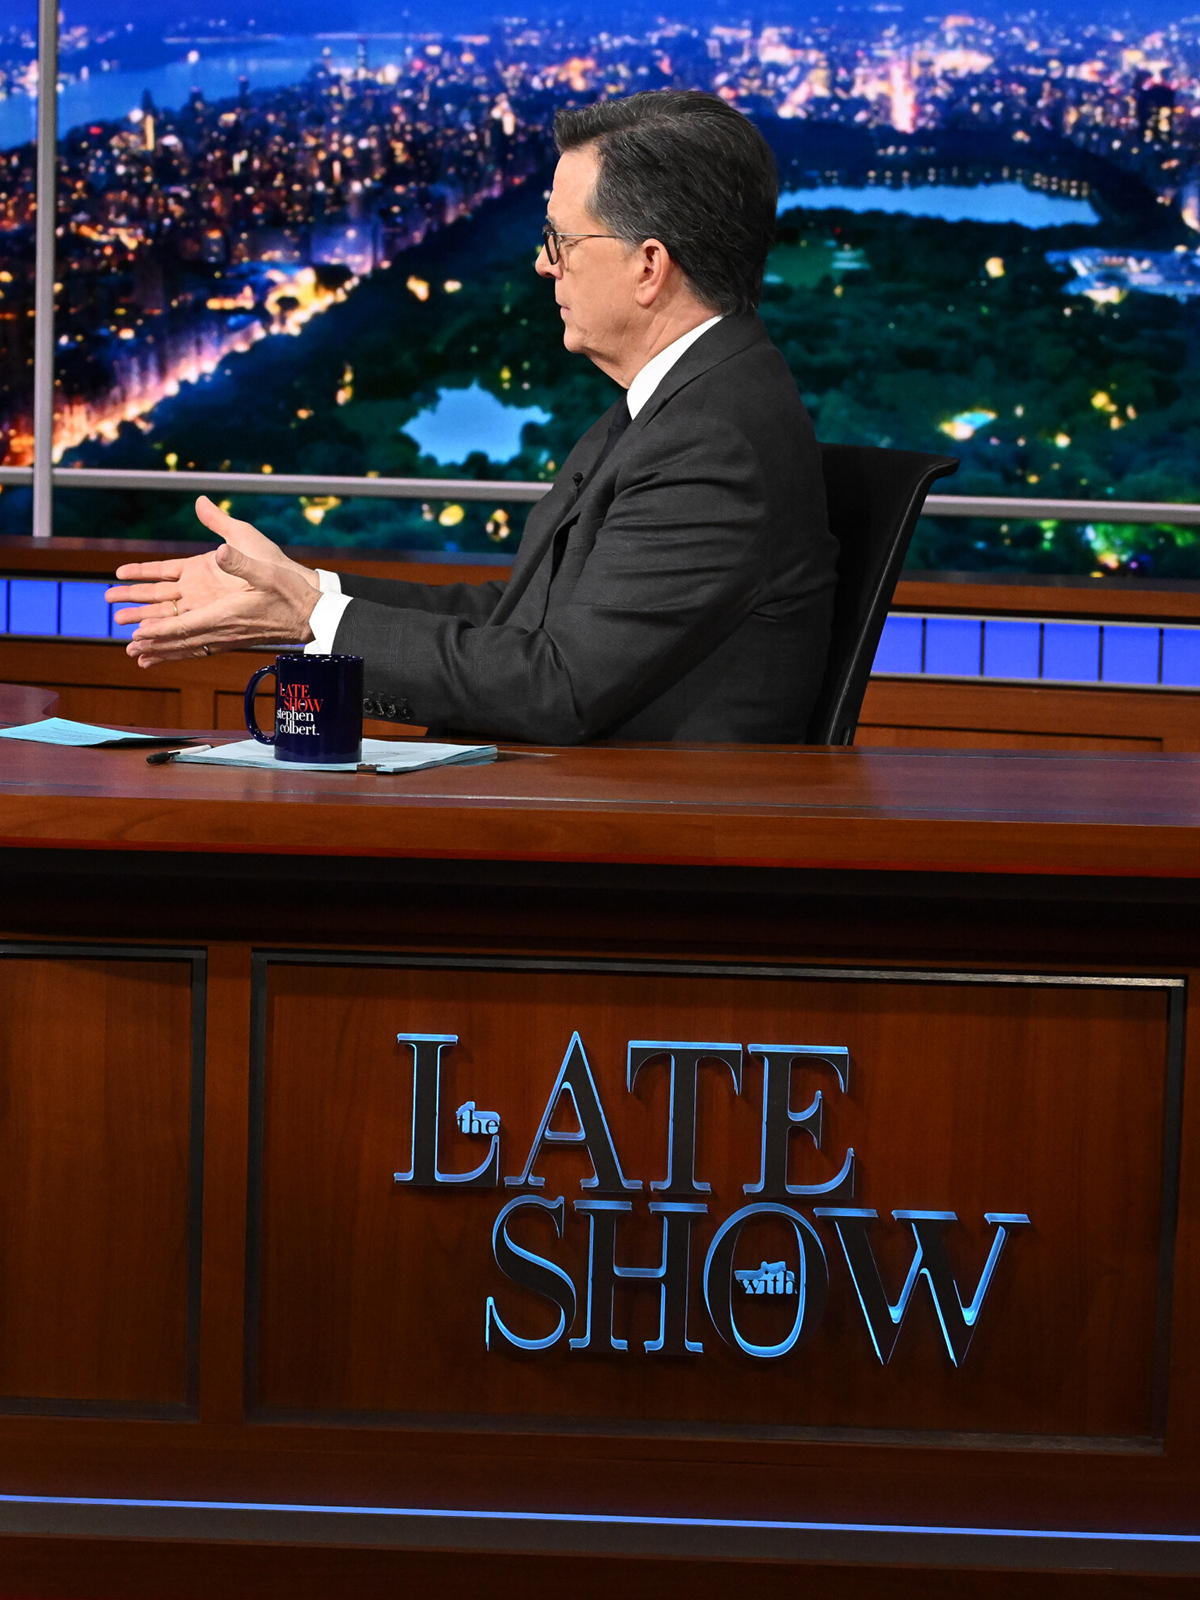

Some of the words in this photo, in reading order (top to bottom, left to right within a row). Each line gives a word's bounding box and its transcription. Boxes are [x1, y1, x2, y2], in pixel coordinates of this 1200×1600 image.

[280, 683, 310, 699] LATE
[276, 706, 314, 724] stephen
[283, 697, 324, 712] SHOW
[280, 720, 320, 736] colbert.
[393, 1030, 856, 1200] LATE
[457, 1105, 500, 1135] the
[485, 1194, 1031, 1367] SHOW
[736, 1266, 799, 1295] with
